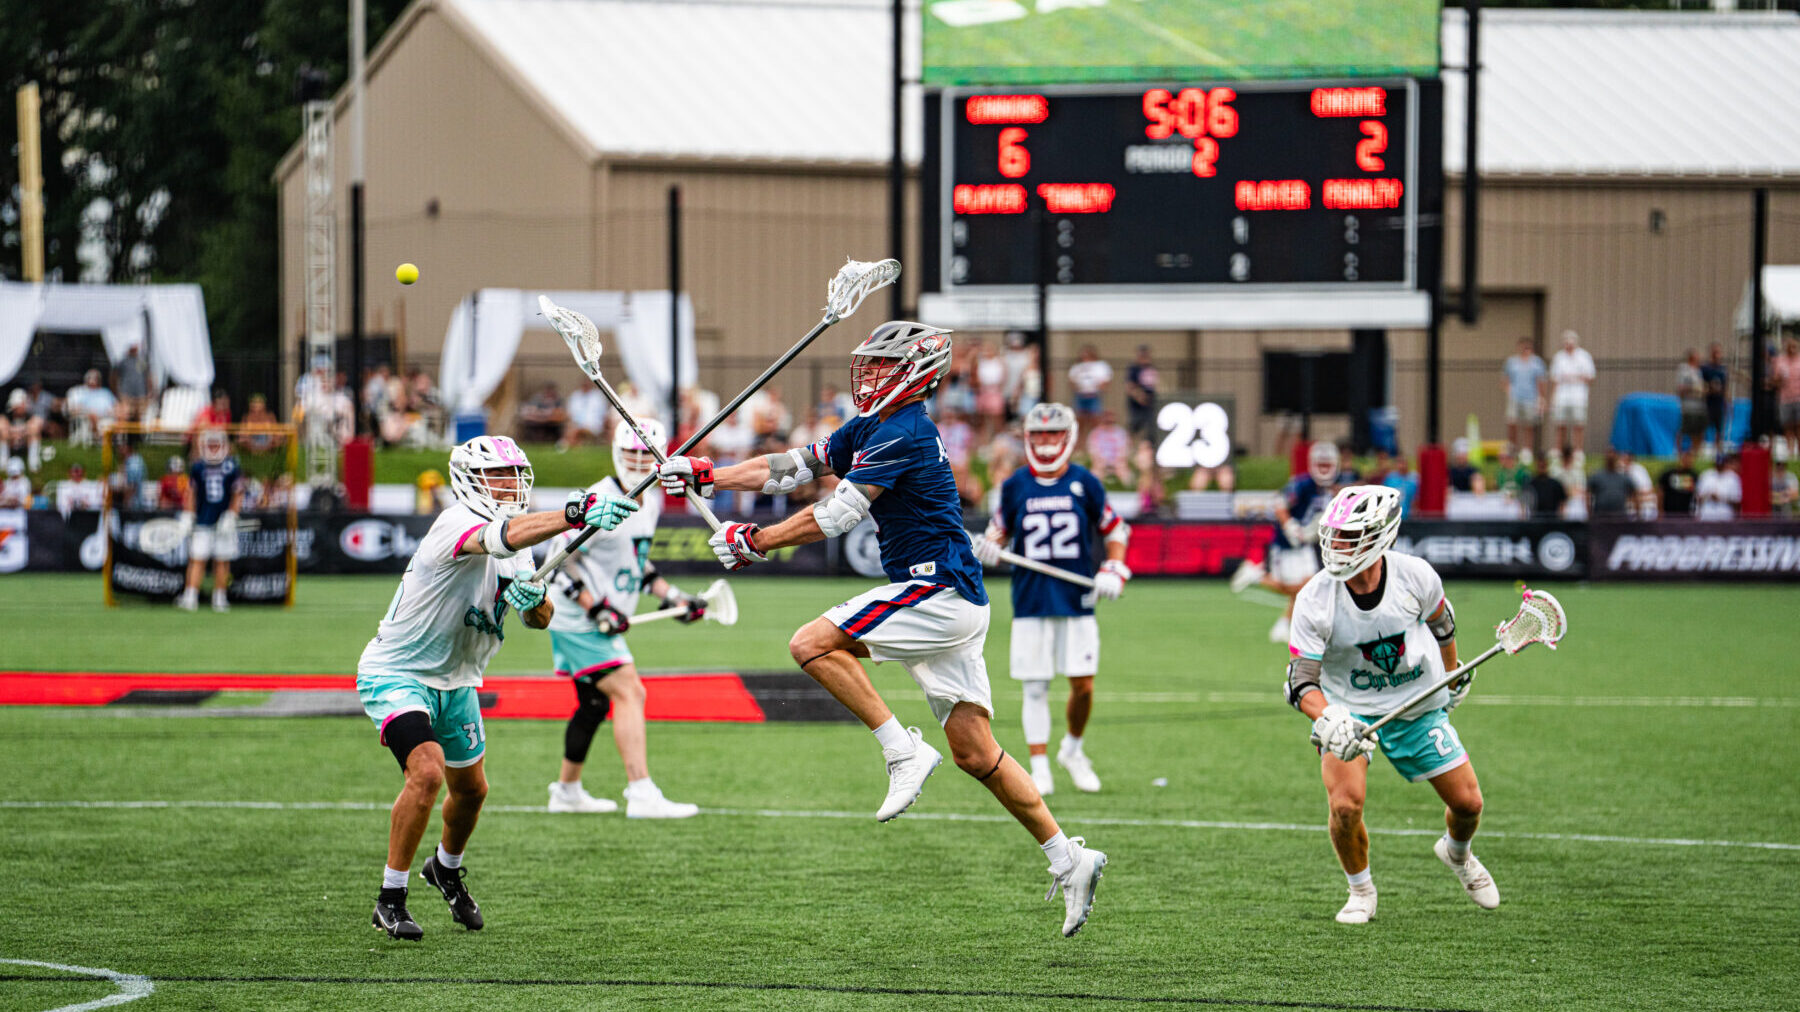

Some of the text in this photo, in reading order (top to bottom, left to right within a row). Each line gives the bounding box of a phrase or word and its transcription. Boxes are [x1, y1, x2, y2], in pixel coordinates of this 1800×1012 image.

[1142, 87, 1239, 140] 5:06
[998, 127, 1030, 178] 6
[1192, 136, 1219, 178] 2
[1356, 120, 1388, 172] 2
[1235, 180, 1311, 211] PLAYER
[1155, 401, 1231, 468] 23
[1022, 513, 1080, 560] 22
[1427, 721, 1462, 757] 21
